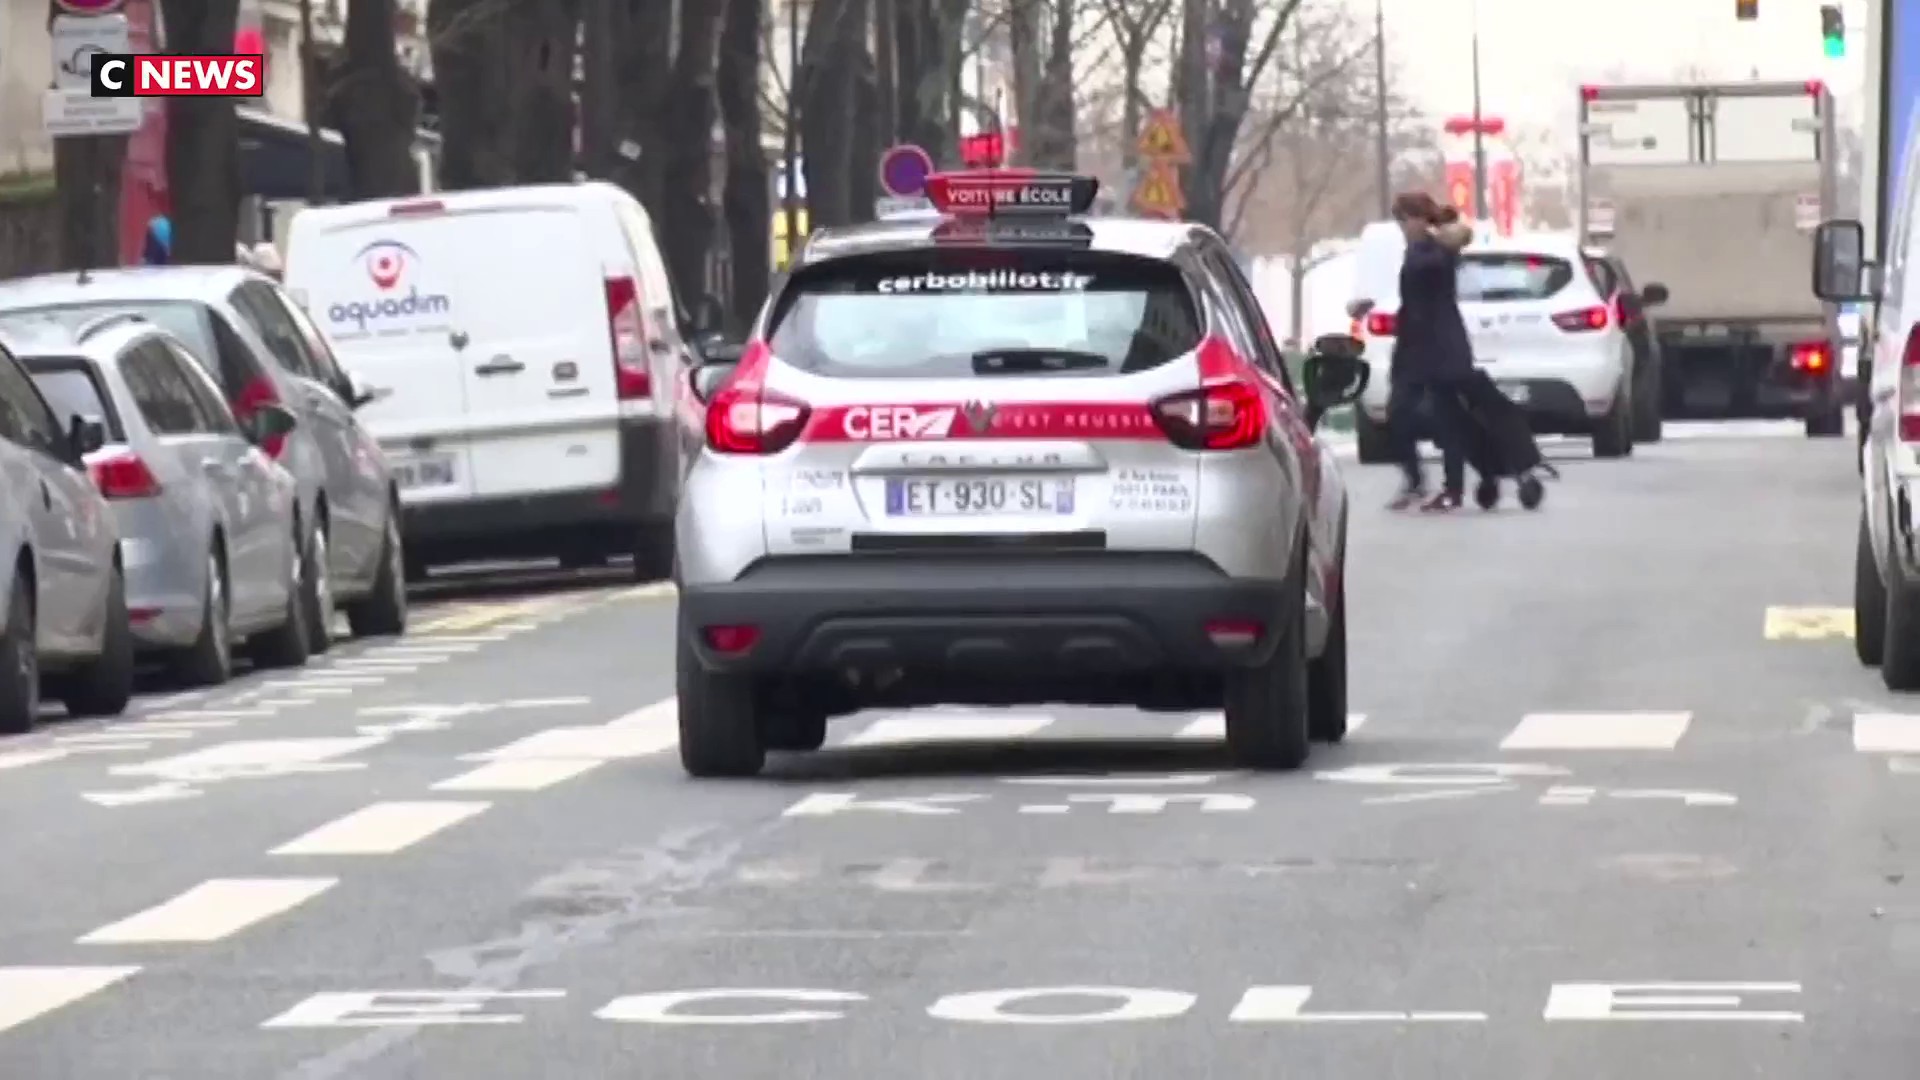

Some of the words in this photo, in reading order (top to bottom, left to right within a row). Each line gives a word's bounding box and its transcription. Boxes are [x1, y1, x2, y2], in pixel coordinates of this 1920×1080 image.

[877, 268, 1091, 293] cerbobillot.fr
[328, 284, 450, 330] aquadim
[262, 982, 1805, 1023] ECOLE
